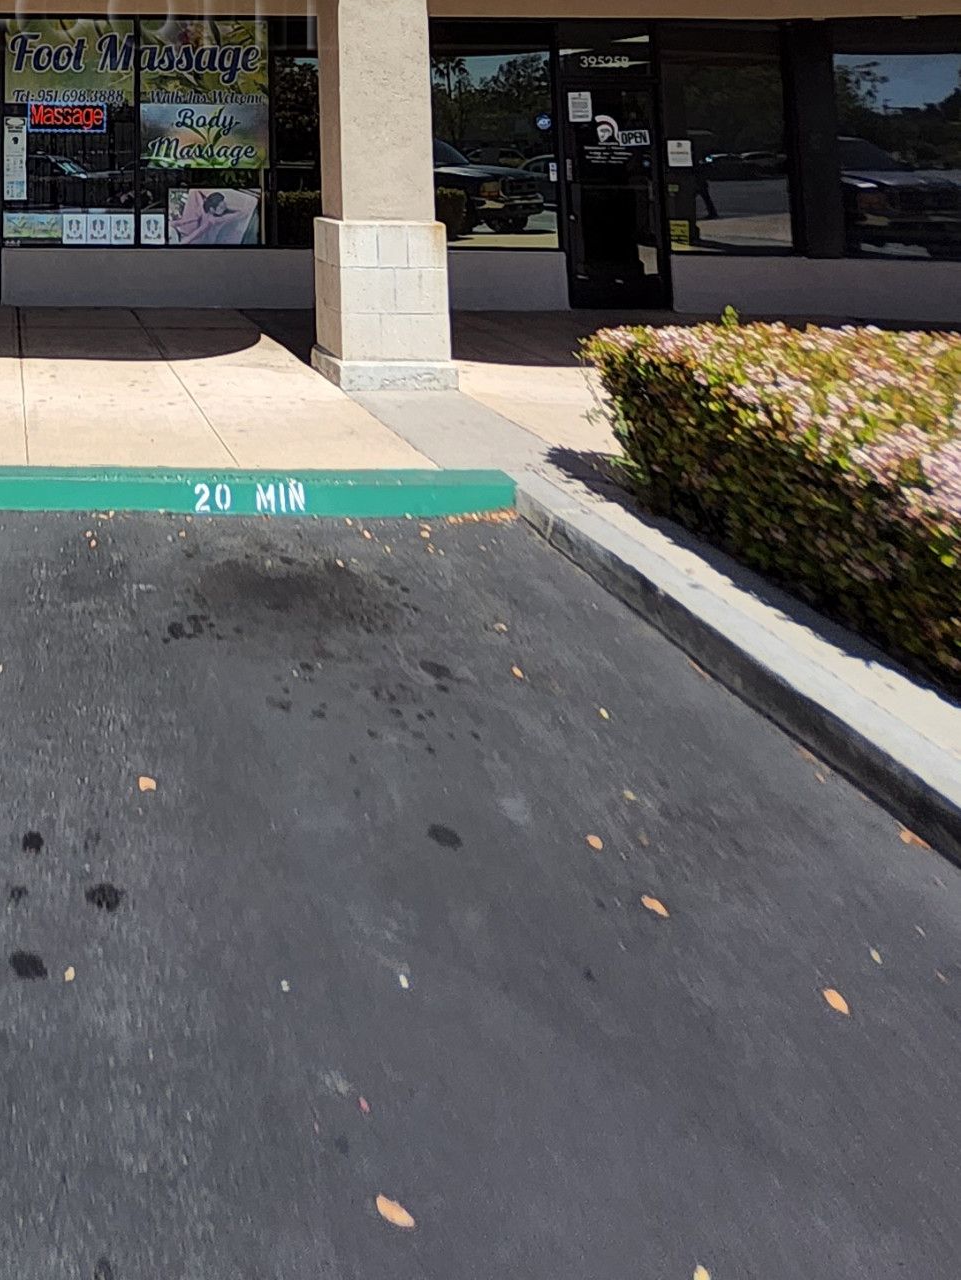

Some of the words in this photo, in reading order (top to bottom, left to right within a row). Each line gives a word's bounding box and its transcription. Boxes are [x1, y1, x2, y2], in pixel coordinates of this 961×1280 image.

[9, 32, 89, 73] Foot
[95, 31, 261, 85] Massage
[30, 104, 104, 130] Massage
[175, 108, 240, 136] Body
[148, 136, 258, 167] Massage
[620, 131, 649, 144] OPEN
[194, 483, 232, 513] 20
[256, 481, 306, 513] MIN
